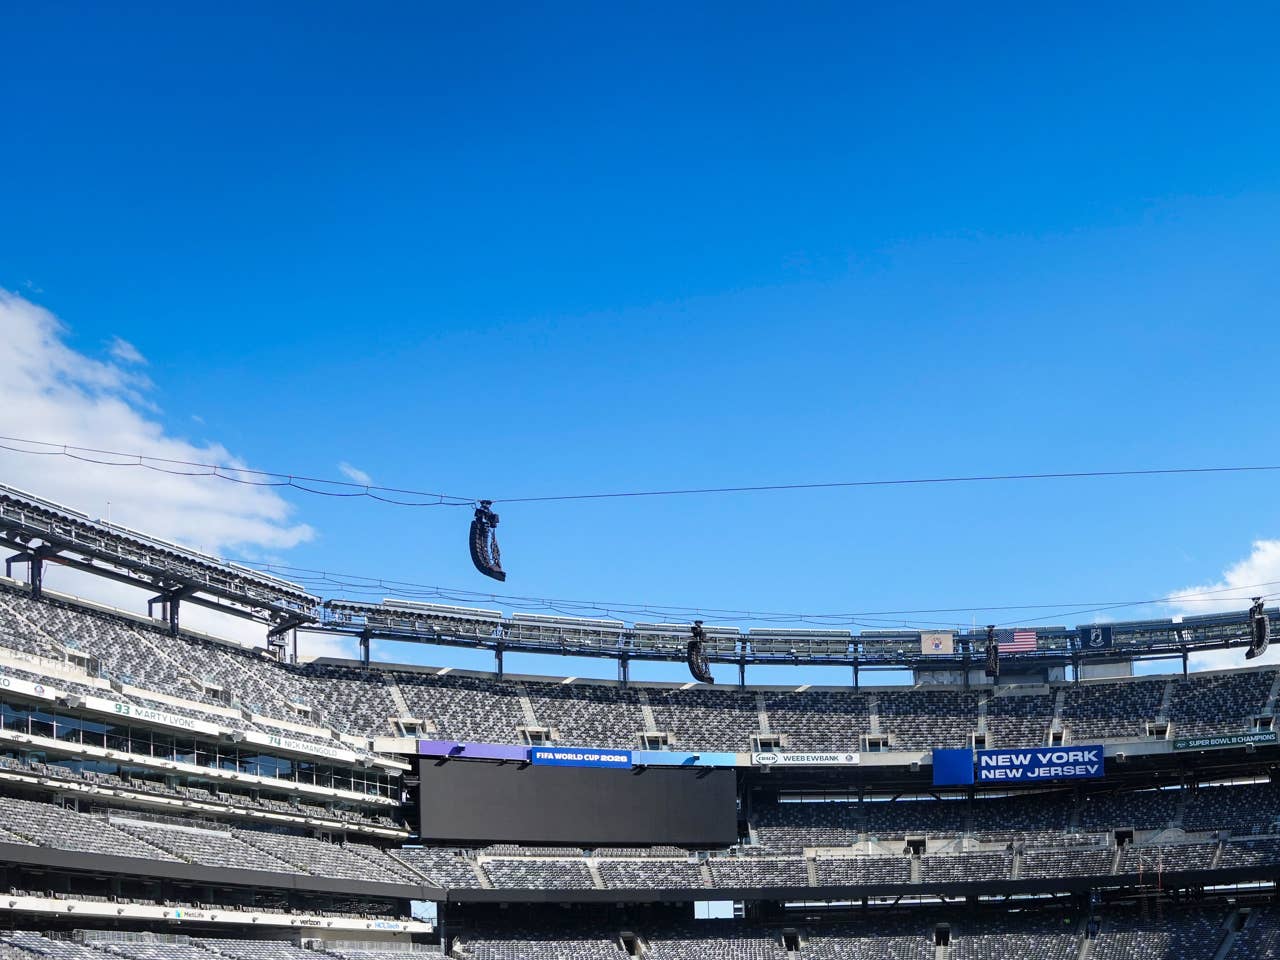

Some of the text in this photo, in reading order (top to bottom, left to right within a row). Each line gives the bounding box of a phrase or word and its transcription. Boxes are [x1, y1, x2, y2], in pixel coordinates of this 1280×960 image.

[114, 703, 196, 728] 93 MARTY LYONS
[267, 735, 282, 747] 74
[301, 743, 338, 757] MANGOLD
[1188, 739, 1209, 747] SUPER
[1237, 733, 1276, 743] CHAMPIONS
[536, 752, 554, 760] FIFA
[554, 752, 583, 761] WORLD
[600, 755, 628, 763] 2026
[981, 750, 1098, 767] NEW YORK
[981, 764, 1099, 779] NEW JERSEY
[299, 918, 321, 926] verizon
